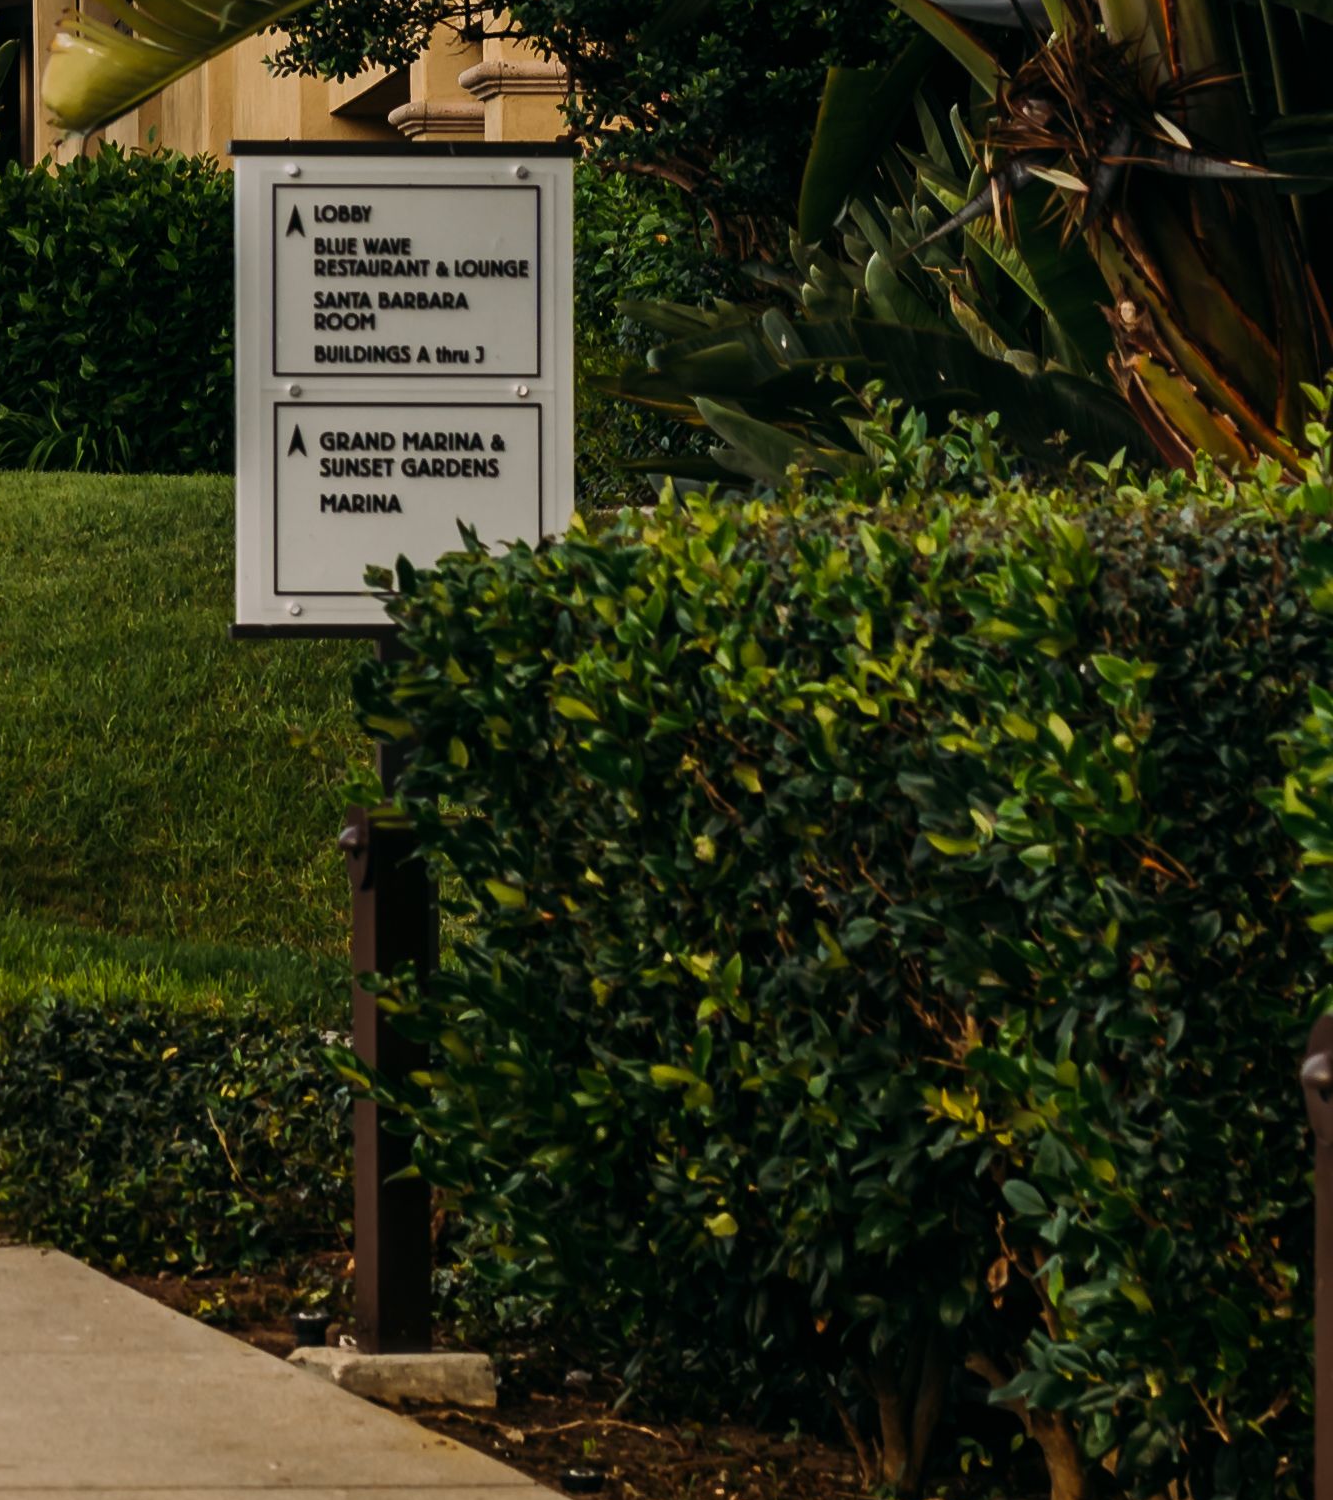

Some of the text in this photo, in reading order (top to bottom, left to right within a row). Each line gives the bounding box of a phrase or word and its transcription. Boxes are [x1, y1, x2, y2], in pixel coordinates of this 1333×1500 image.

[313, 204, 373, 225] LOBBY
[313, 237, 412, 257] BLUE WAVE
[313, 258, 530, 280] RESTAURANT & LOUNGE
[313, 290, 470, 311] SANTA BARBARA
[313, 311, 377, 332] ROOM
[313, 344, 486, 365] BUILDINGS A thru J
[319, 431, 506, 453] GRAND MARINA &
[319, 457, 500, 479] SUNSET GARDENS
[319, 493, 403, 514] MARINA
